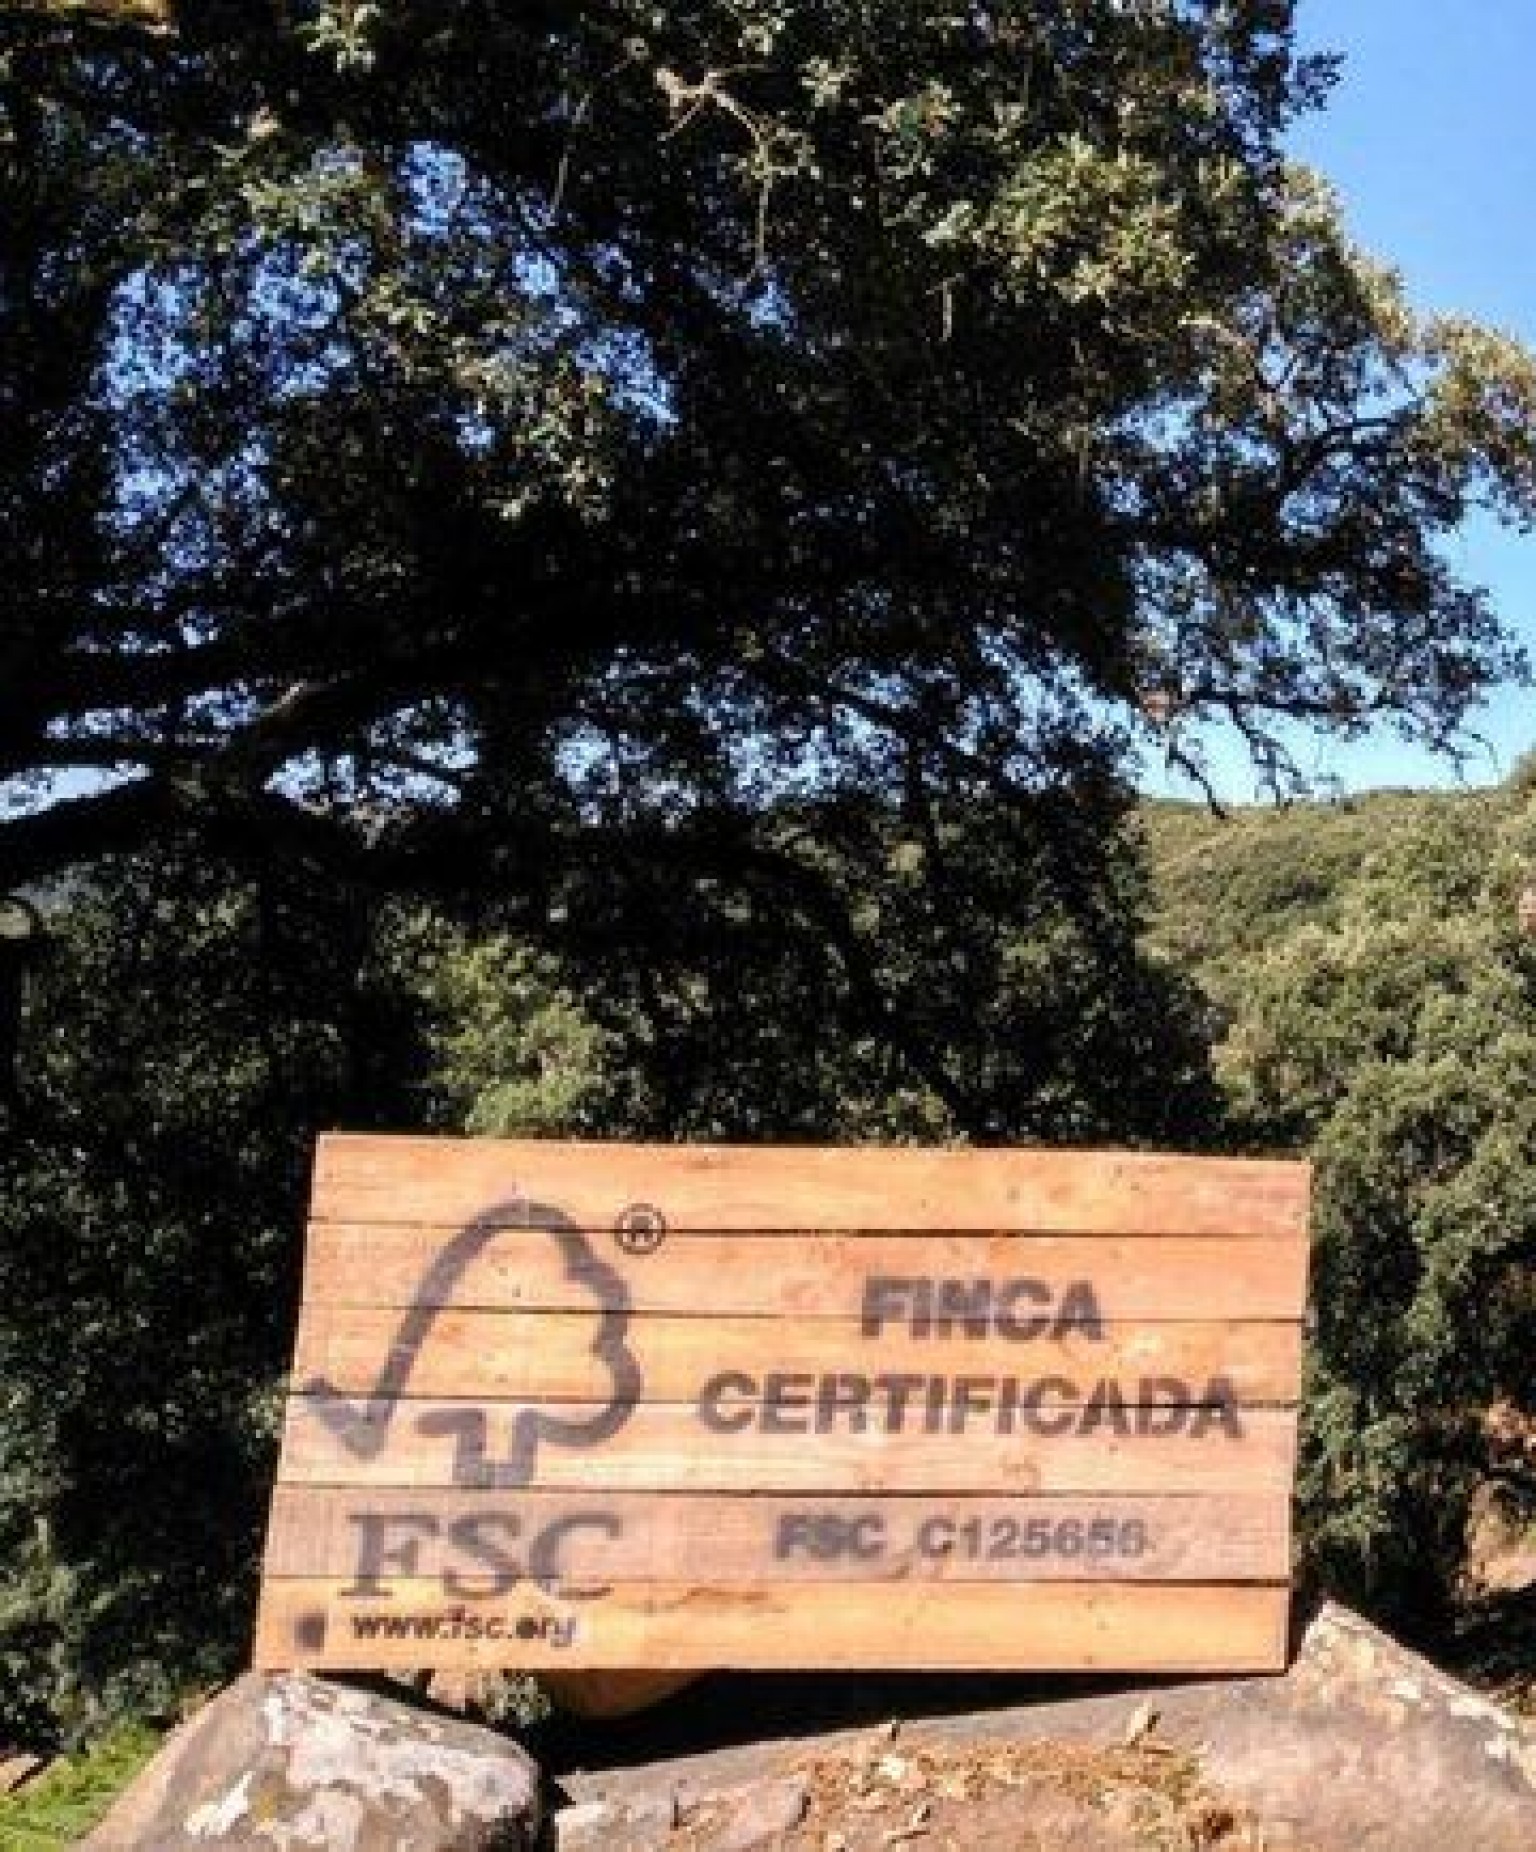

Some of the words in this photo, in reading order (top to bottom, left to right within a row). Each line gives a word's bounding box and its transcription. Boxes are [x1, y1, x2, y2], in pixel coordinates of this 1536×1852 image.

[860, 1274, 1105, 1342] FINCA
[699, 1369, 1245, 1439] CERTIFICADA
[340, 1510, 622, 1598] FSC
[773, 1513, 887, 1561] FSC
